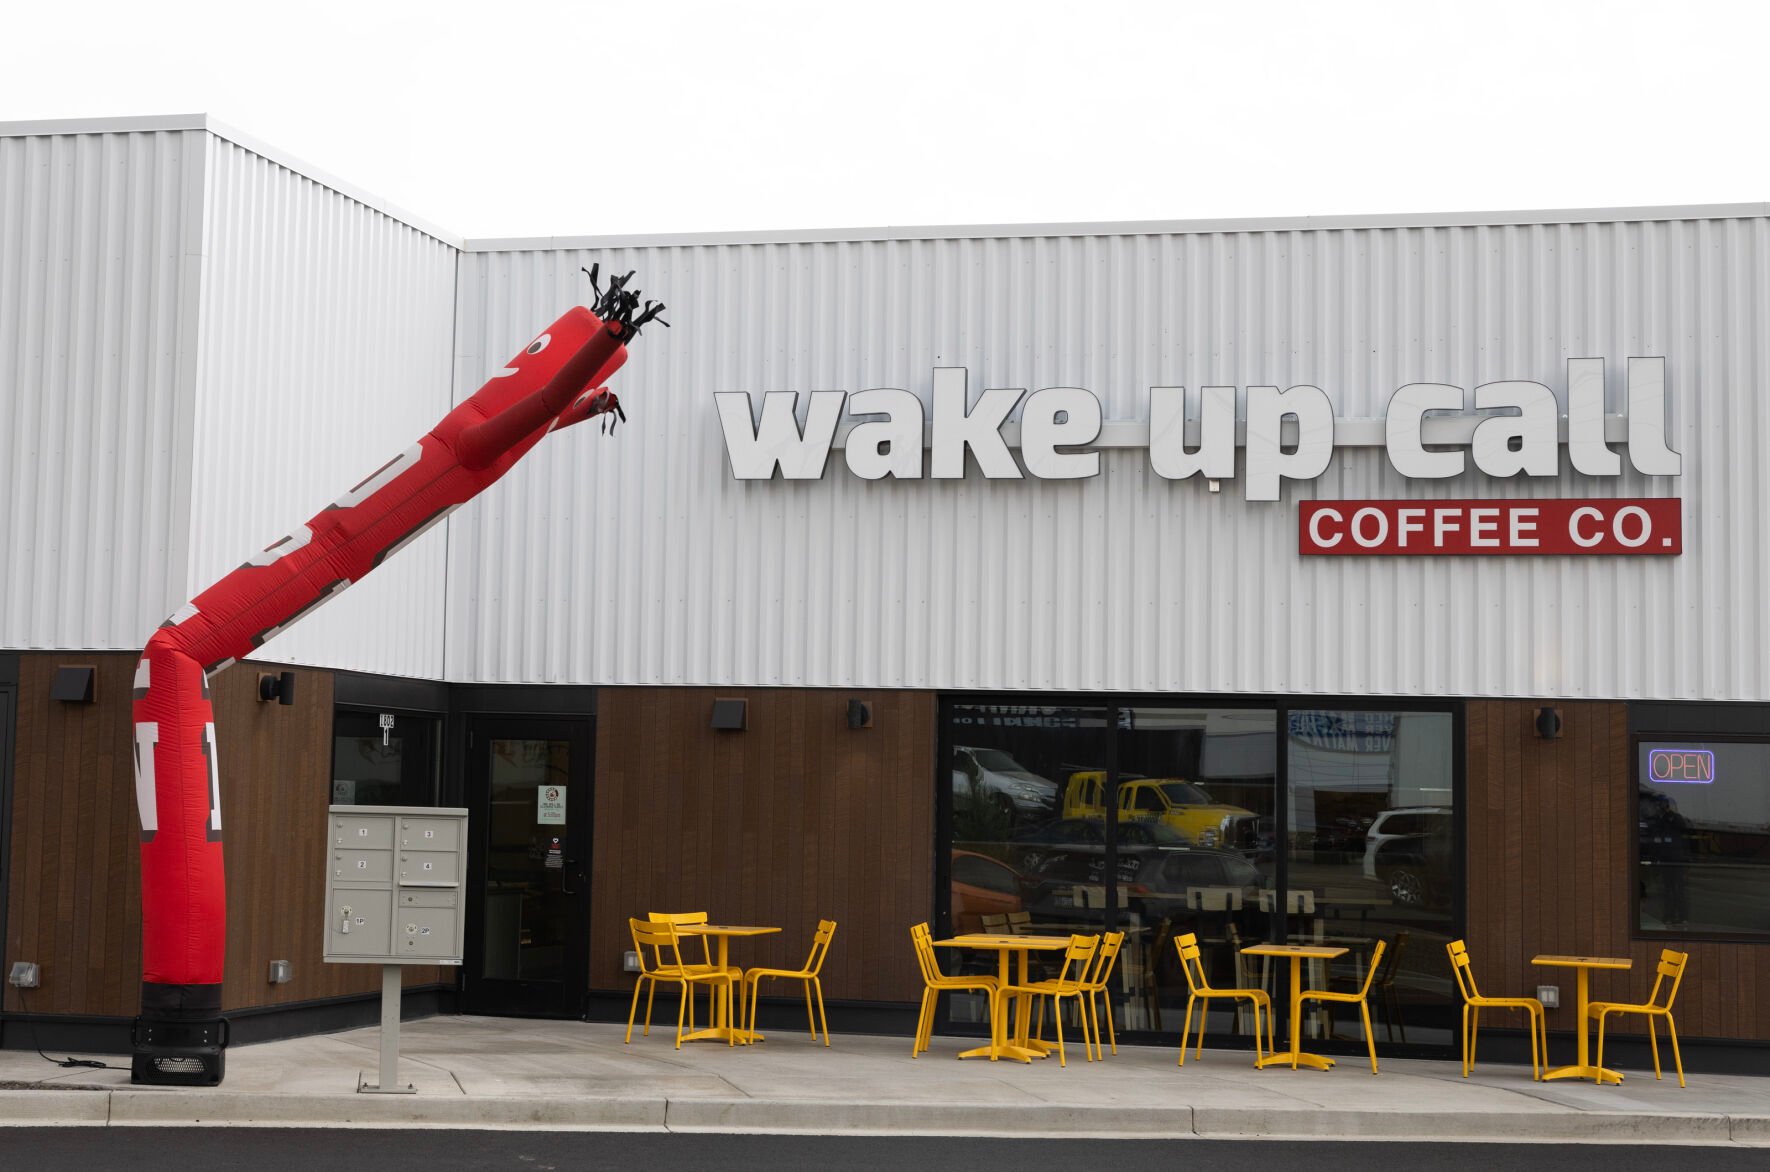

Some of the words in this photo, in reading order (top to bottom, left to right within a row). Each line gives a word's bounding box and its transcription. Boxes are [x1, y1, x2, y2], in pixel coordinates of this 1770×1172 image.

[713, 366, 1101, 480] wake
[1149, 385, 1335, 502] up
[1385, 356, 1682, 479] call
[1308, 507, 1540, 548] COFFEE
[1568, 505, 1672, 548] CO.
[1653, 753, 1711, 780] OPEN
